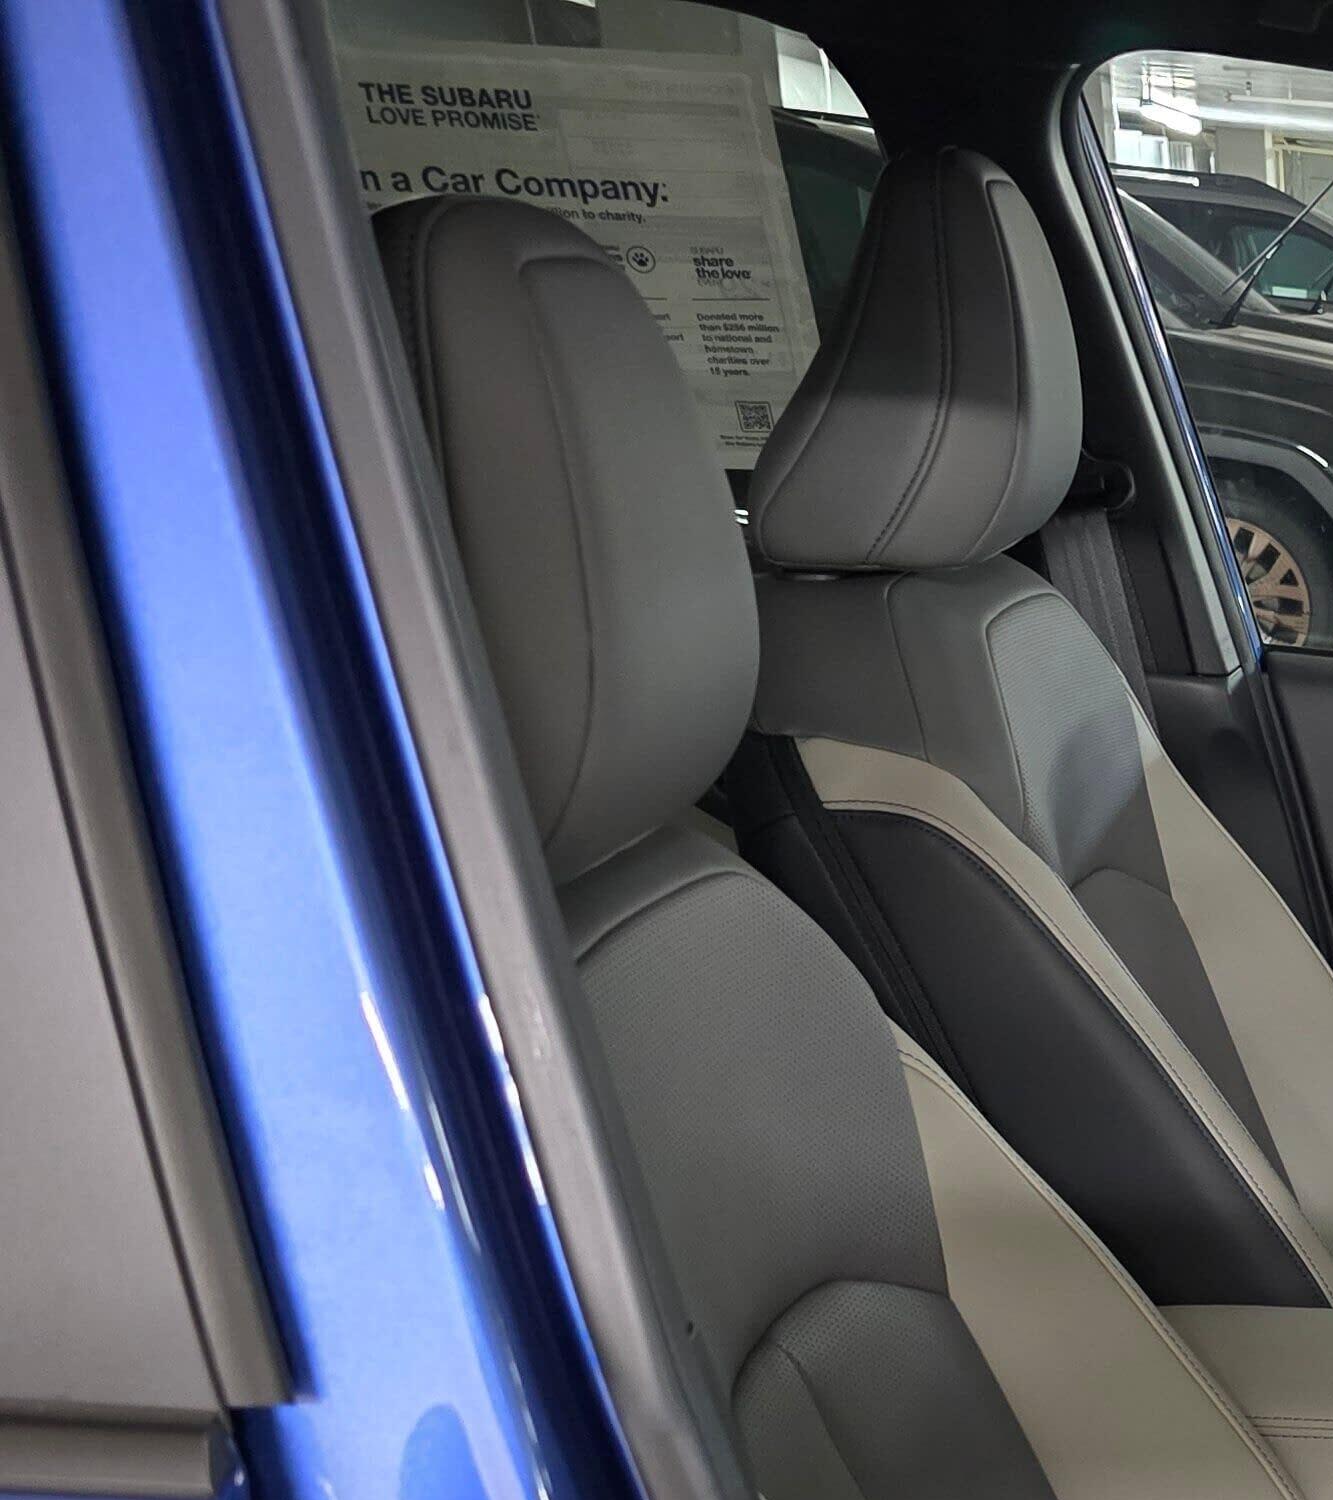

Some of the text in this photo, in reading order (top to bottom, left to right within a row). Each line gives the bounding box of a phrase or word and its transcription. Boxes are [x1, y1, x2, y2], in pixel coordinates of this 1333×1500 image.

[358, 81, 533, 110] THE SUBARU
[366, 105, 427, 127] LOVE
[391, 171, 414, 193] a
[421, 165, 485, 194] Car
[582, 209, 596, 219] to
[692, 255, 735, 268] share
[696, 312, 764, 322] Donated more
[699, 323, 722, 332] than
[747, 324, 780, 333] million
[702, 334, 773, 343] to national and
[704, 344, 754, 354] hometown
[707, 355, 770, 366] charities over
